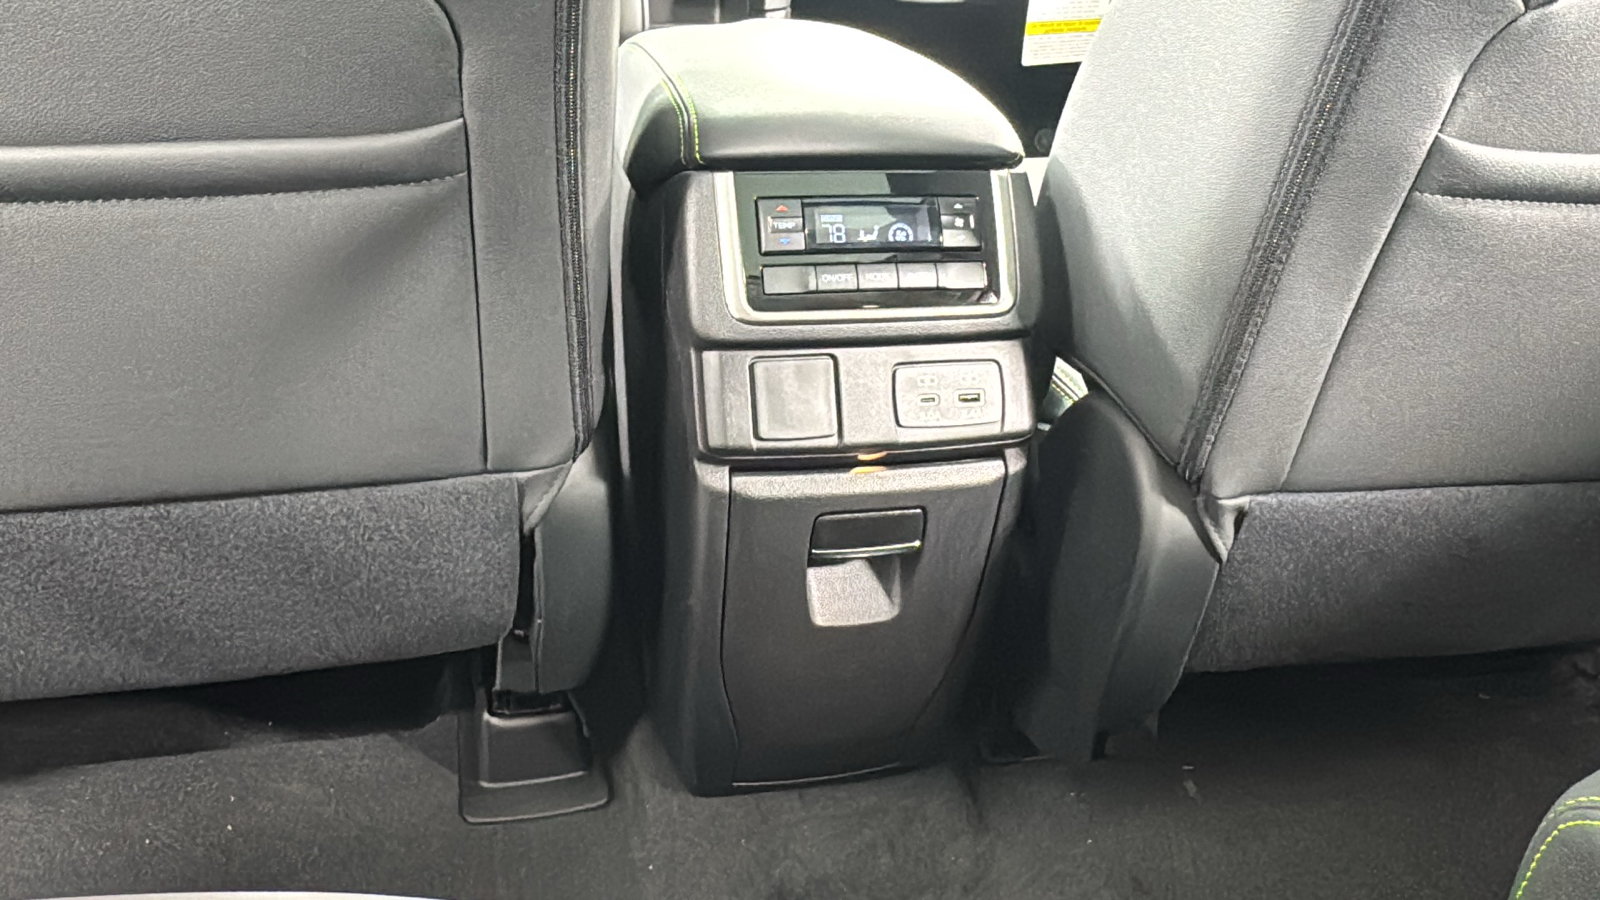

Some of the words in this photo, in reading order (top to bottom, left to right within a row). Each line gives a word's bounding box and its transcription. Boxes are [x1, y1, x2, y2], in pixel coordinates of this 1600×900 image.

[773, 221, 796, 229] TEMP
[821, 224, 846, 243] 78
[821, 273, 853, 282] ON/OFF
